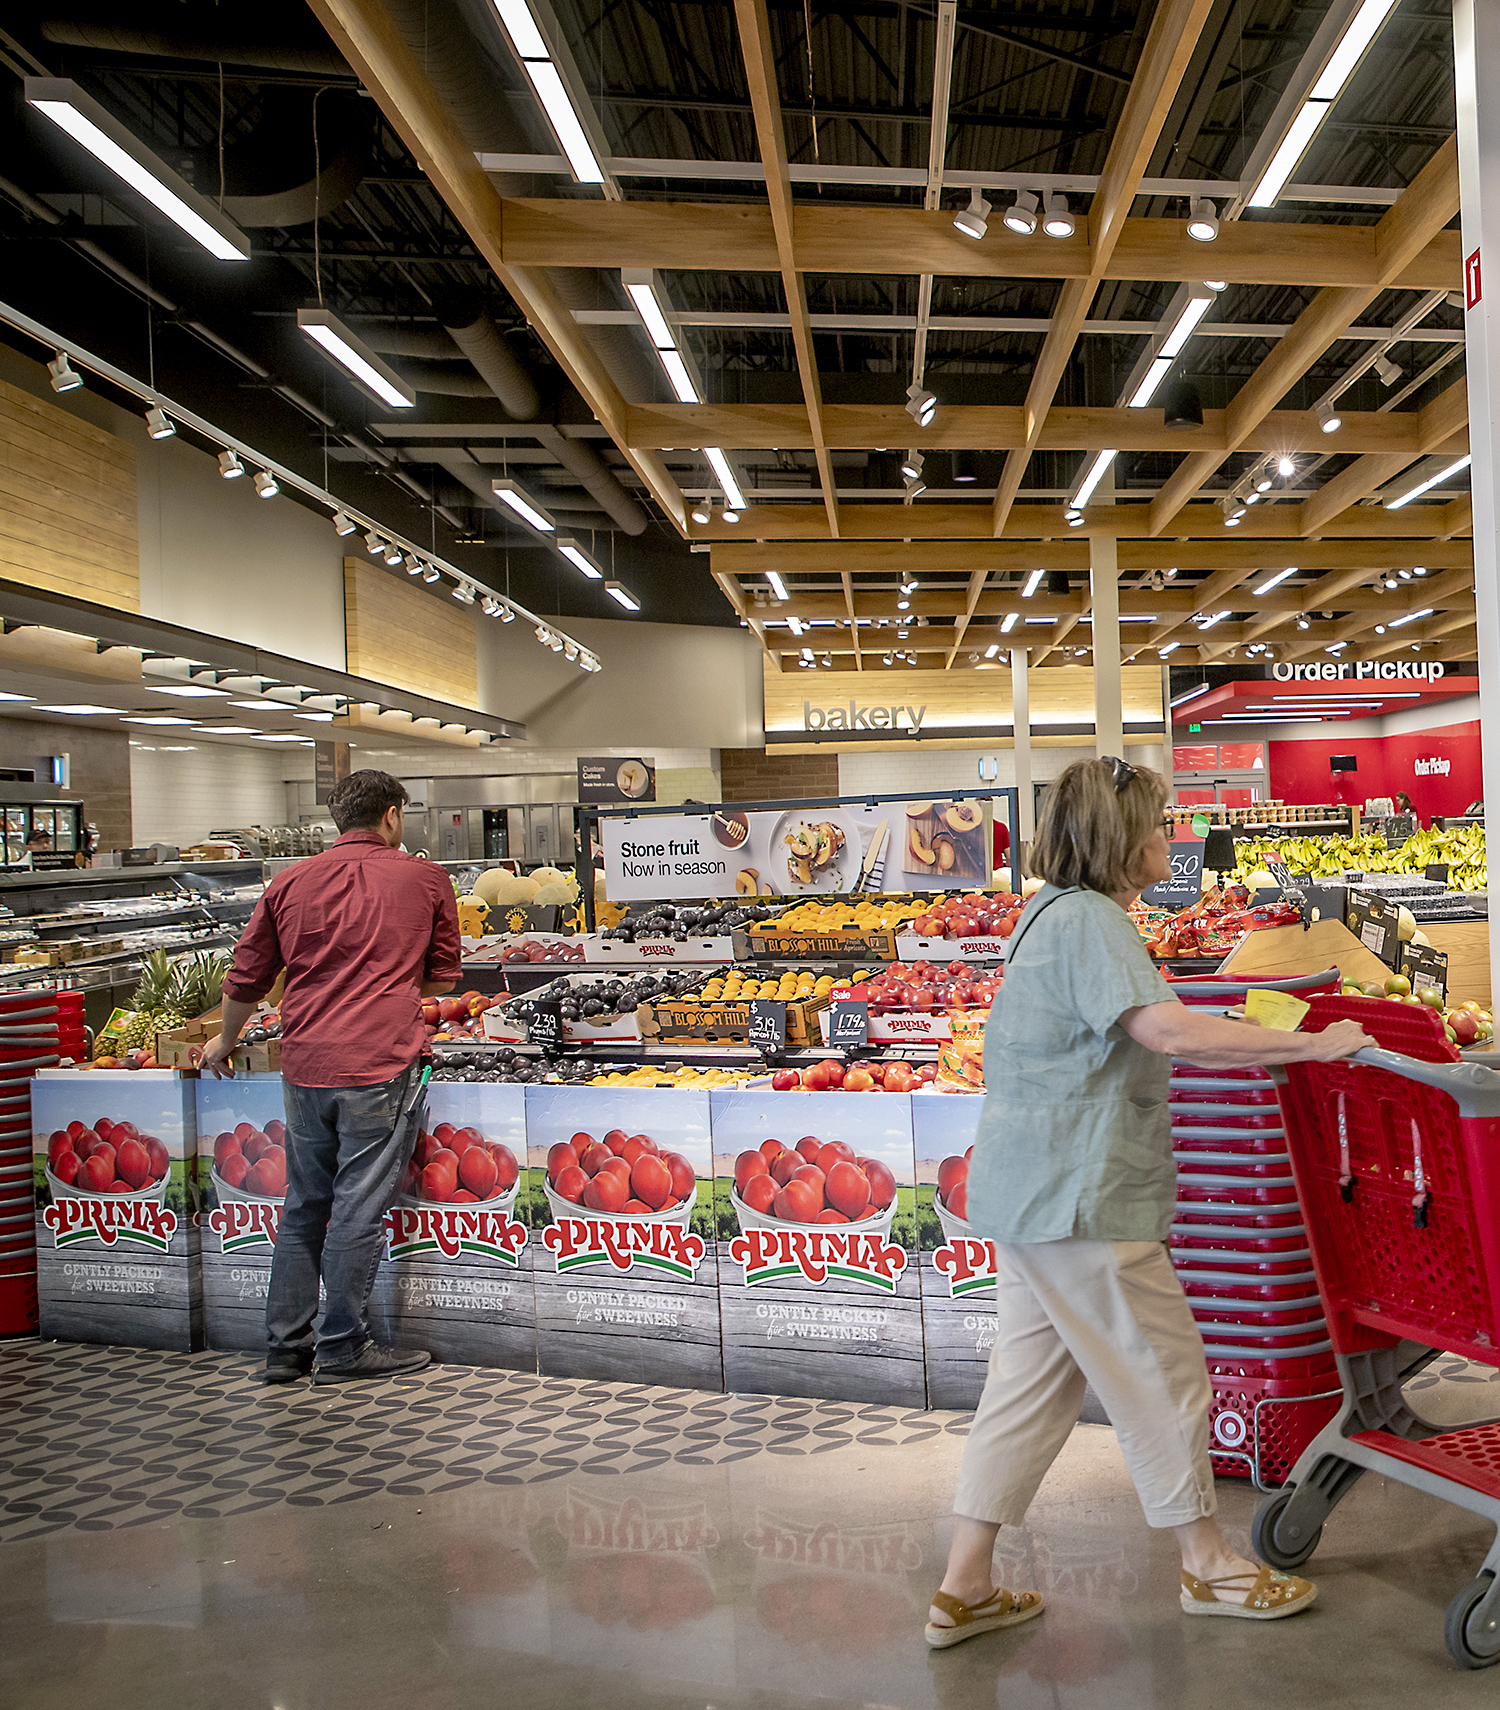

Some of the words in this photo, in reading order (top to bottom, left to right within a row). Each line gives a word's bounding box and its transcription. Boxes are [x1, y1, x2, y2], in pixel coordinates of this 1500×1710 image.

[1273, 662, 1349, 682] Order
[1357, 661, 1445, 683] Pickup
[804, 700, 926, 735] bakery
[1415, 759, 1430, 776] Order
[1430, 757, 1450, 777] Pickup
[621, 842, 665, 857] Stone
[668, 839, 700, 856] fruit
[623, 861, 654, 878] Now
[658, 860, 670, 876] in
[674, 861, 726, 876] season
[1170, 854, 1199, 876] 50
[639, 945, 676, 956] PRIMA
[768, 938, 815, 953] BLOSSOM
[818, 938, 843, 951] HILL
[960, 942, 1001, 954] PRIMA
[832, 990, 851, 1000] Sale
[528, 1001, 535, 1011] $
[750, 1000, 759, 1014] $
[830, 1001, 839, 1014] $
[674, 1011, 722, 1029] BLOSSOM
[723, 1012, 749, 1026] HILL
[887, 1020, 931, 1032] PRIMA
[44, 1199, 177, 1246] PRIMA
[211, 1203, 284, 1247] PRI
[384, 1209, 527, 1256] PRIMA
[544, 1219, 704, 1269] PRIMA
[731, 1230, 905, 1283] PRIMA
[63, 1264, 110, 1278] GENTLY
[111, 1265, 162, 1280] PACKED
[231, 1269, 271, 1282] GENT
[86, 1280, 155, 1294] SWEETNESS
[399, 1277, 453, 1292] GENTLY
[457, 1281, 511, 1296] PACKED
[425, 1294, 503, 1310] SWEETNESS
[566, 1290, 625, 1306] GENTLY
[628, 1294, 687, 1311] PACKED
[576, 1304, 592, 1325] for
[594, 1308, 678, 1327] SWEETNESS
[756, 1304, 819, 1321] GENTLY
[822, 1308, 888, 1325] PACKED
[964, 1316, 999, 1331] GEN
[767, 1319, 785, 1340] for
[787, 1323, 878, 1341] SWEETNESS
